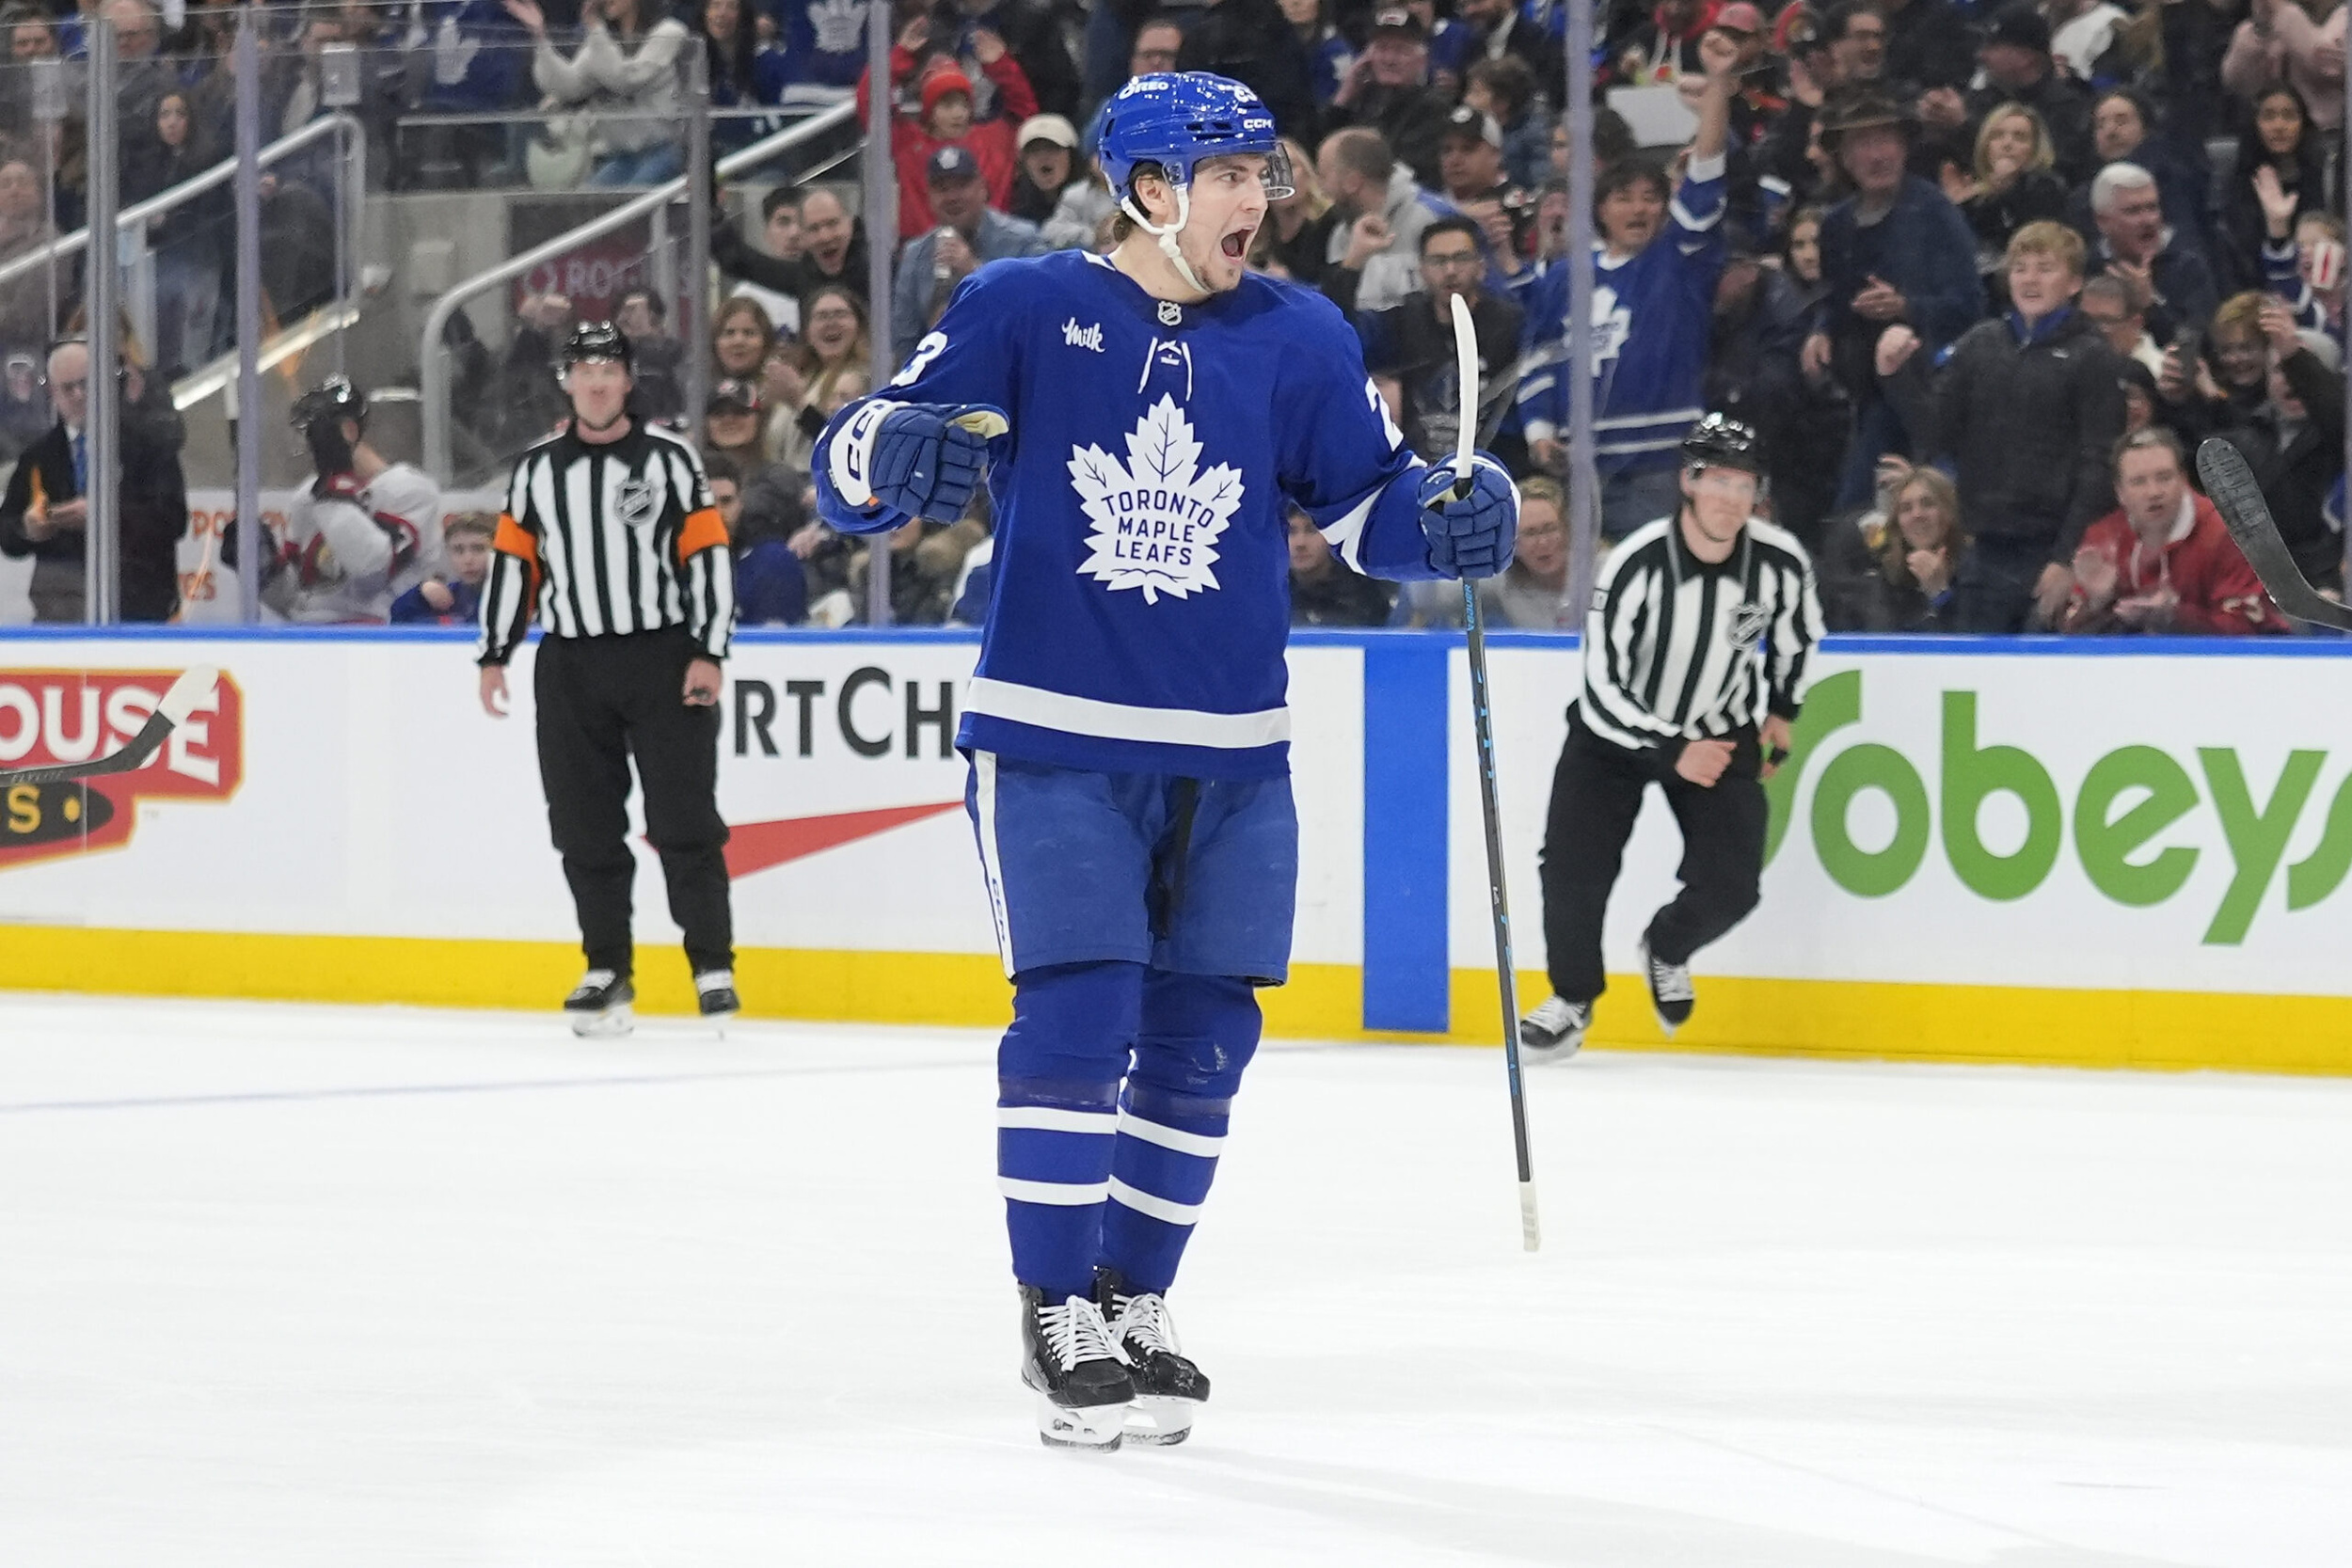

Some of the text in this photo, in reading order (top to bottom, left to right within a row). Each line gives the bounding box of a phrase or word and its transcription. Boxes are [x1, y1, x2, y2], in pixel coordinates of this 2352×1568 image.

[1118, 81, 1168, 100] OREO
[1243, 118, 1272, 130] CCM
[1061, 316, 1106, 353] Milk
[1101, 488, 1215, 529] TORONTO
[1118, 515, 1195, 543] MAPLE
[1115, 539, 1193, 566] LEAFS
